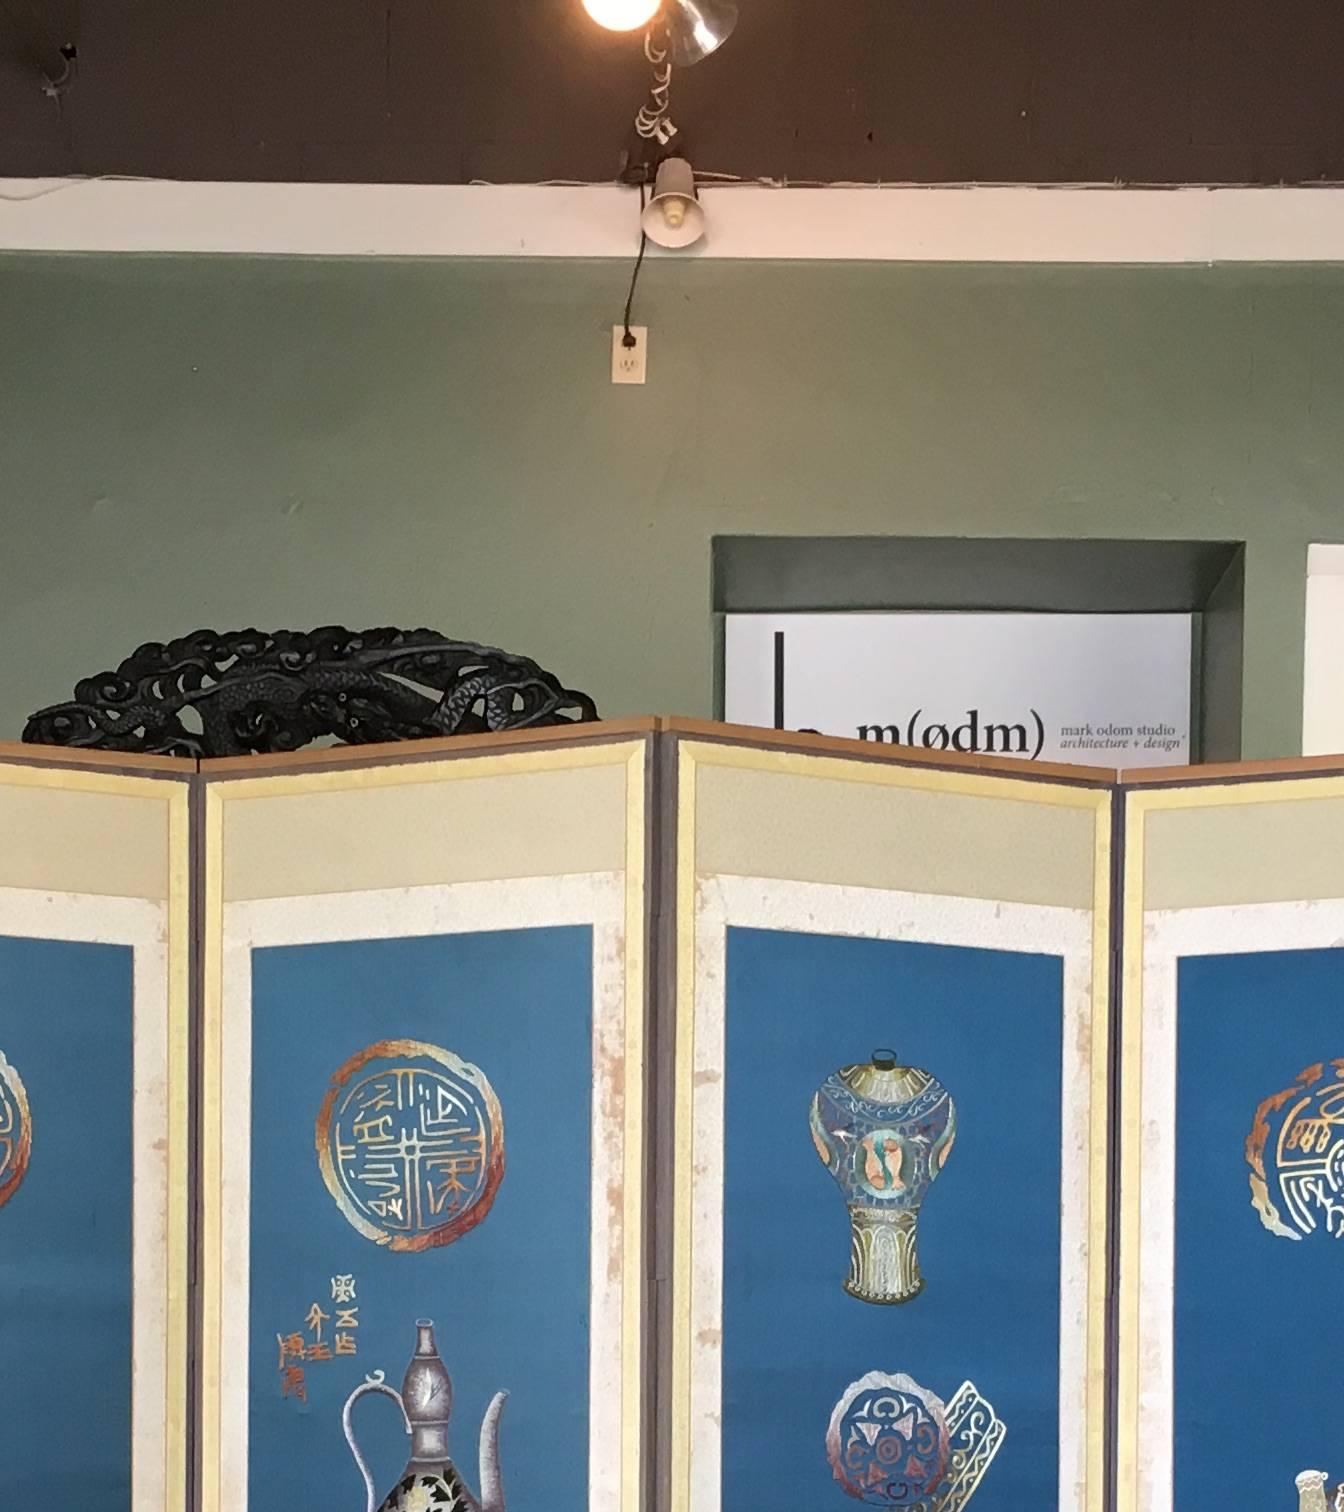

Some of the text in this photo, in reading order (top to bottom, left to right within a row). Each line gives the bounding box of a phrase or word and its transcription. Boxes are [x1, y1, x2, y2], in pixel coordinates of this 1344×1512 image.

[1060, 723, 1176, 736] mark odom studio
[1059, 737, 1129, 749] architecture
[1143, 737, 1181, 751] design
